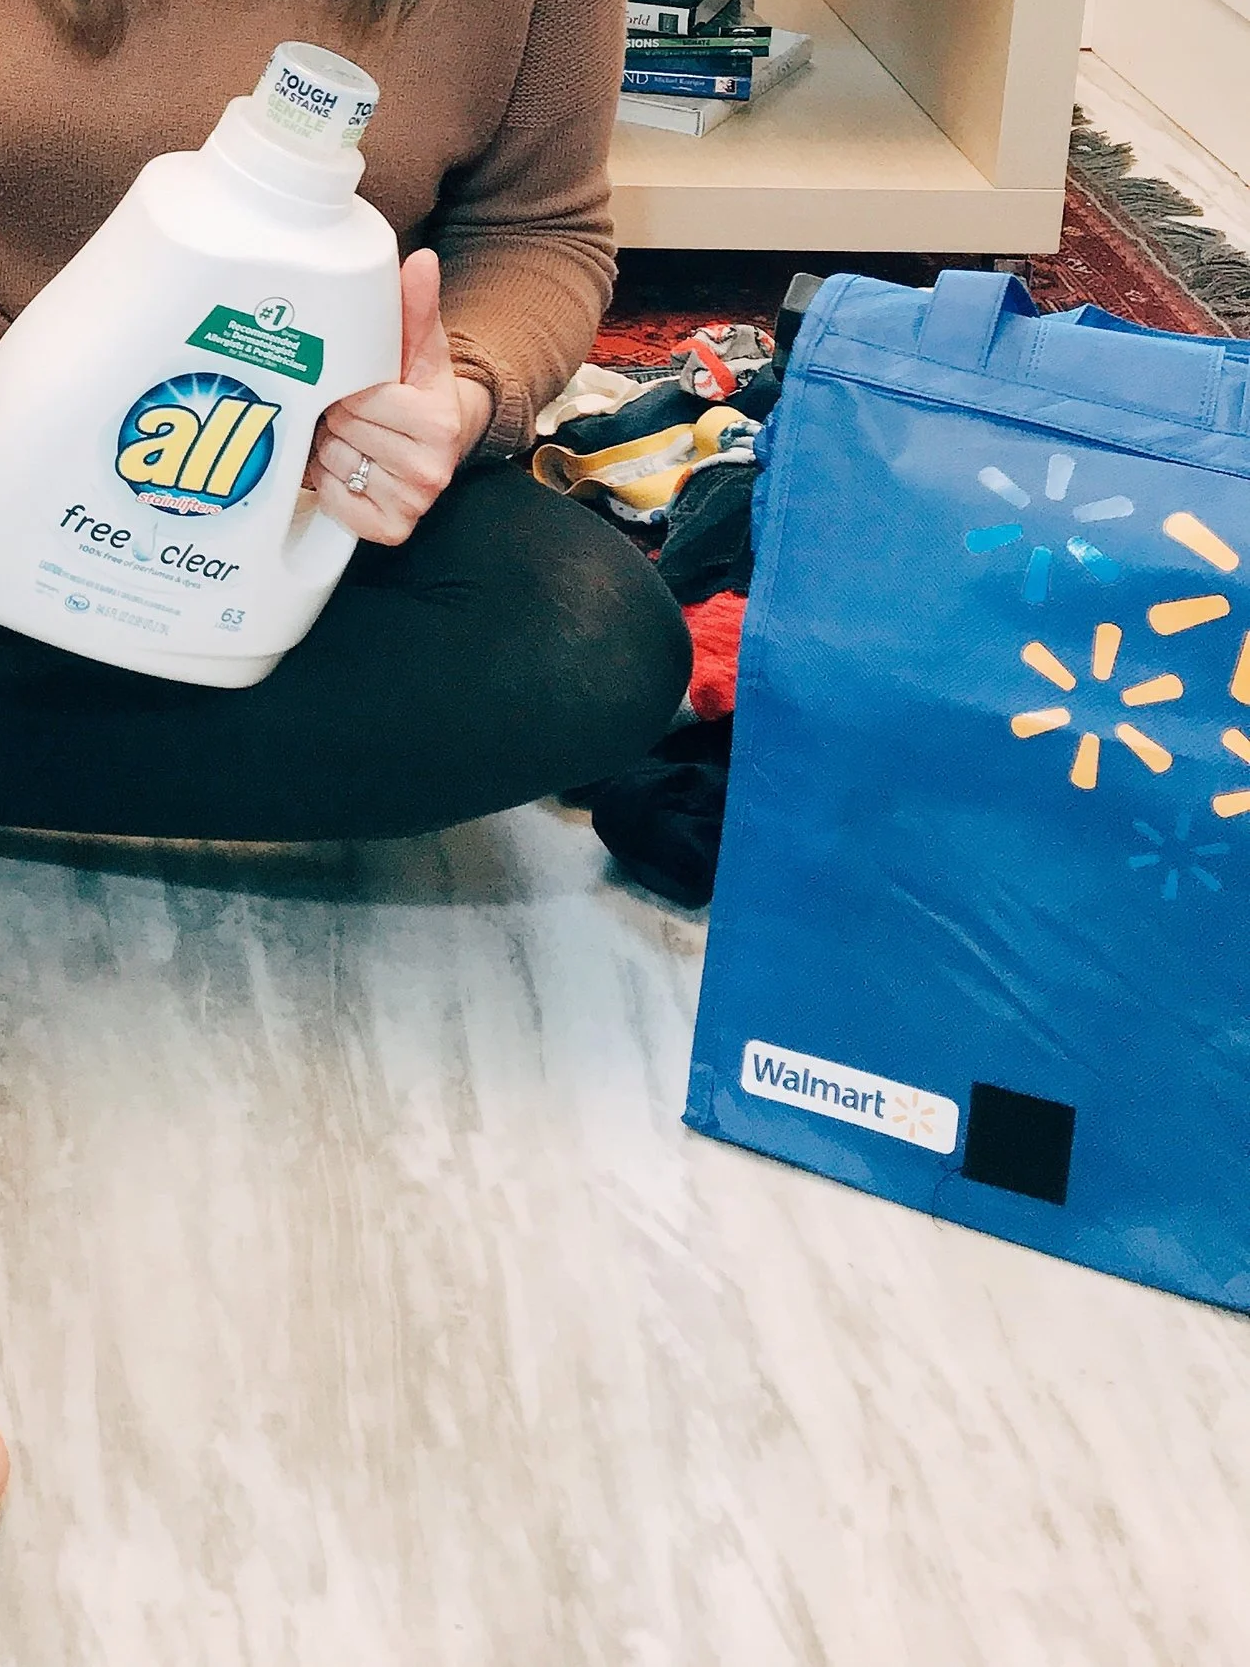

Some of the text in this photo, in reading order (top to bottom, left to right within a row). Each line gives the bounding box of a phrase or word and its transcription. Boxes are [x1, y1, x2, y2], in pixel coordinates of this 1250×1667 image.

[275, 82, 288, 97] ON
[278, 68, 338, 109] TOUGH
[268, 94, 327, 132] GENTLE
[228, 319, 300, 350] Recommended
[259, 305, 287, 326] #1
[204, 332, 308, 372] Allergists & Pediatricians
[232, 331, 297, 358] Dermatologists
[115, 395, 282, 498] all
[137, 492, 222, 515] stainlifters
[60, 504, 240, 582] free clear
[78, 543, 102, 559] 100%
[103, 552, 123, 565] free
[124, 560, 133, 568] of
[134, 562, 174, 582] perfumes
[221, 608, 245, 625] 63
[754, 1053, 886, 1120] Walmart
